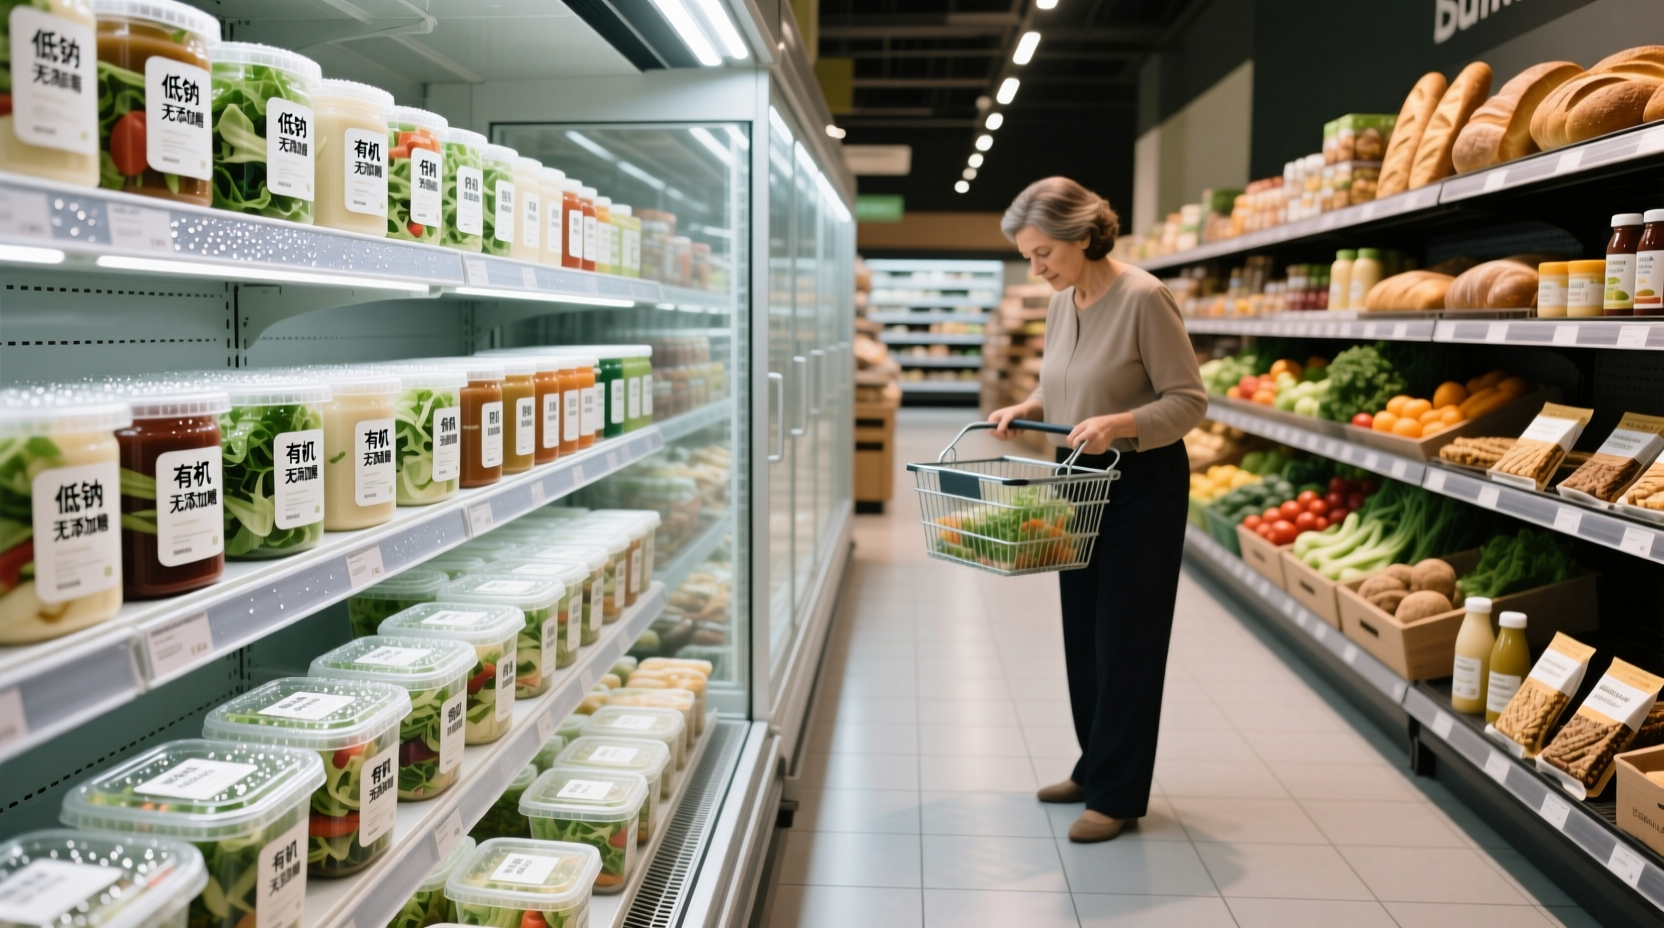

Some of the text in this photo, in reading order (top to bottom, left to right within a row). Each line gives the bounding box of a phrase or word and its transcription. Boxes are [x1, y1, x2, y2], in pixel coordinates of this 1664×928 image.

[31, 29, 80, 69] 低钠
[161, 73, 199, 106] 低钠
[354, 139, 381, 162] 有机
[286, 440, 317, 464] 有机
[173, 460, 212, 489] 有机
[55, 478, 103, 514] 低钠
